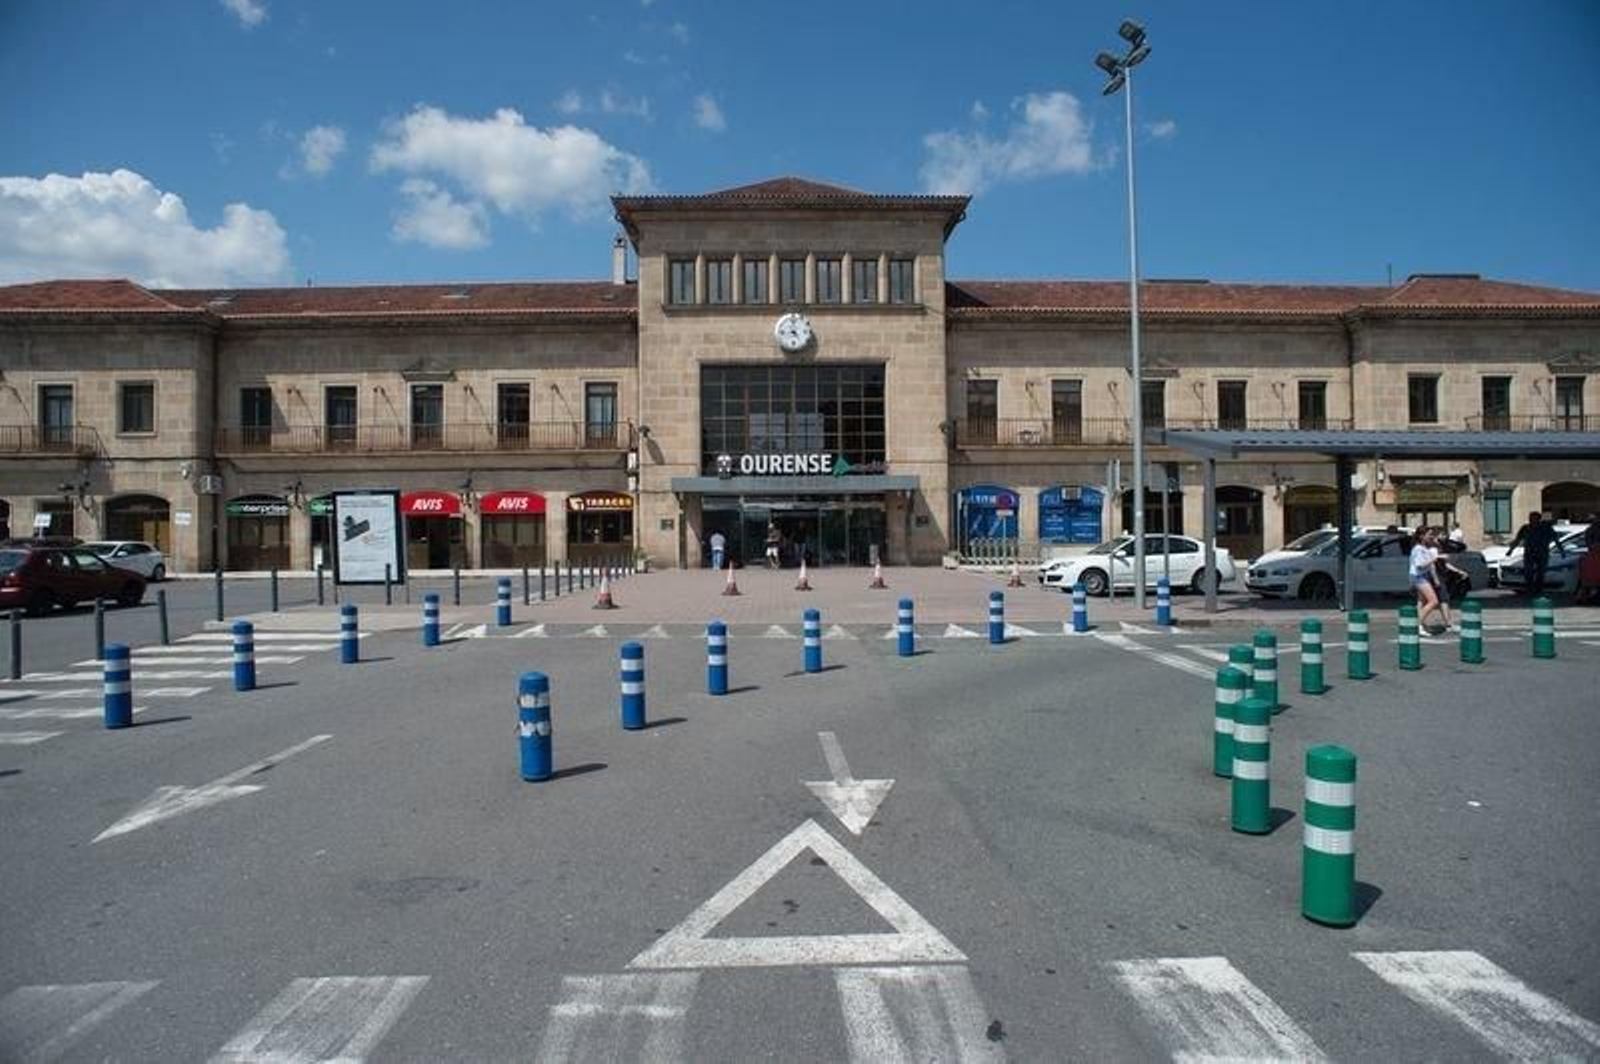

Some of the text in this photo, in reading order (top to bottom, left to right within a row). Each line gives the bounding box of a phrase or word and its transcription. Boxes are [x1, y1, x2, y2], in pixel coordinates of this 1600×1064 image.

[740, 454, 832, 474] OURENSE
[412, 498, 444, 510] AVIS
[497, 497, 528, 509] AVIS
